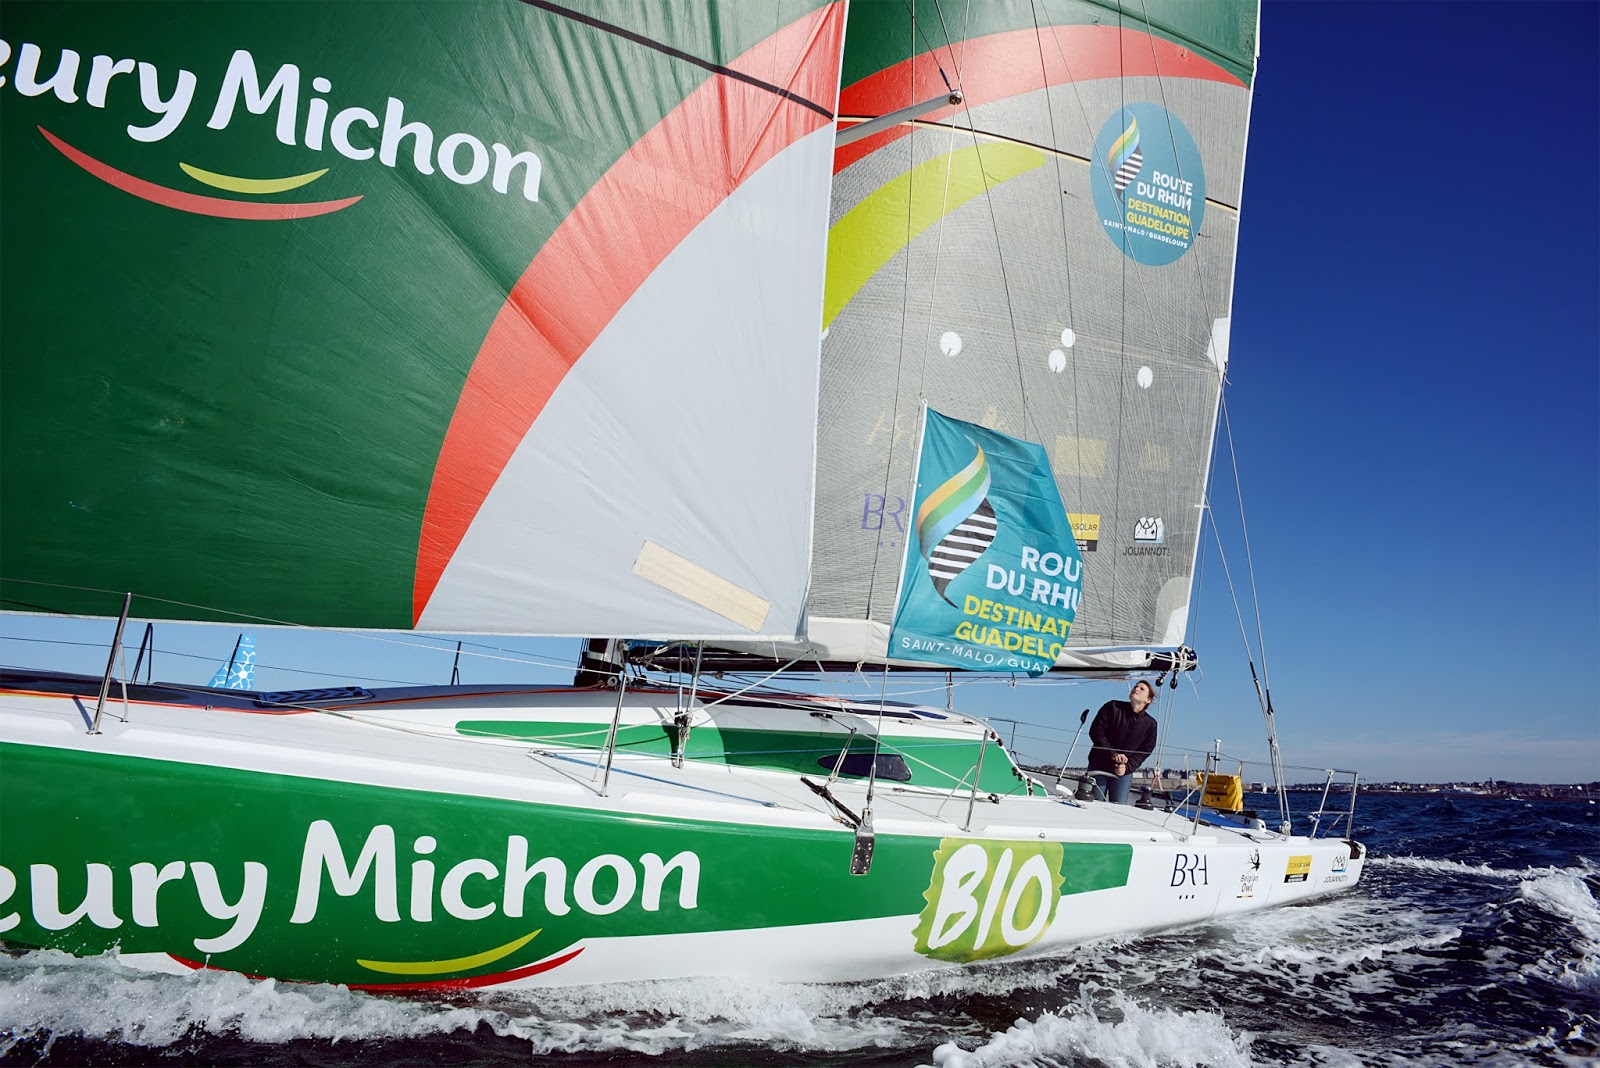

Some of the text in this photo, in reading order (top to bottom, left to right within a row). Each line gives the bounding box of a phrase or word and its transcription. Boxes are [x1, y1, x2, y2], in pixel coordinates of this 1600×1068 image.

[207, 49, 542, 202] Michon
[1137, 182, 1191, 211] DU RHUM
[1153, 170, 1193, 196] ROUTE
[1126, 211, 1189, 240] GUADELOUPE
[1128, 198, 1190, 226] DESTINATION
[986, 564, 1025, 596] DU
[1021, 546, 1082, 582] ROU
[963, 595, 1072, 638] DESTINAT
[955, 621, 1063, 662] GUADELO
[289, 820, 700, 923] Michon
[927, 844, 1052, 950] BIO
